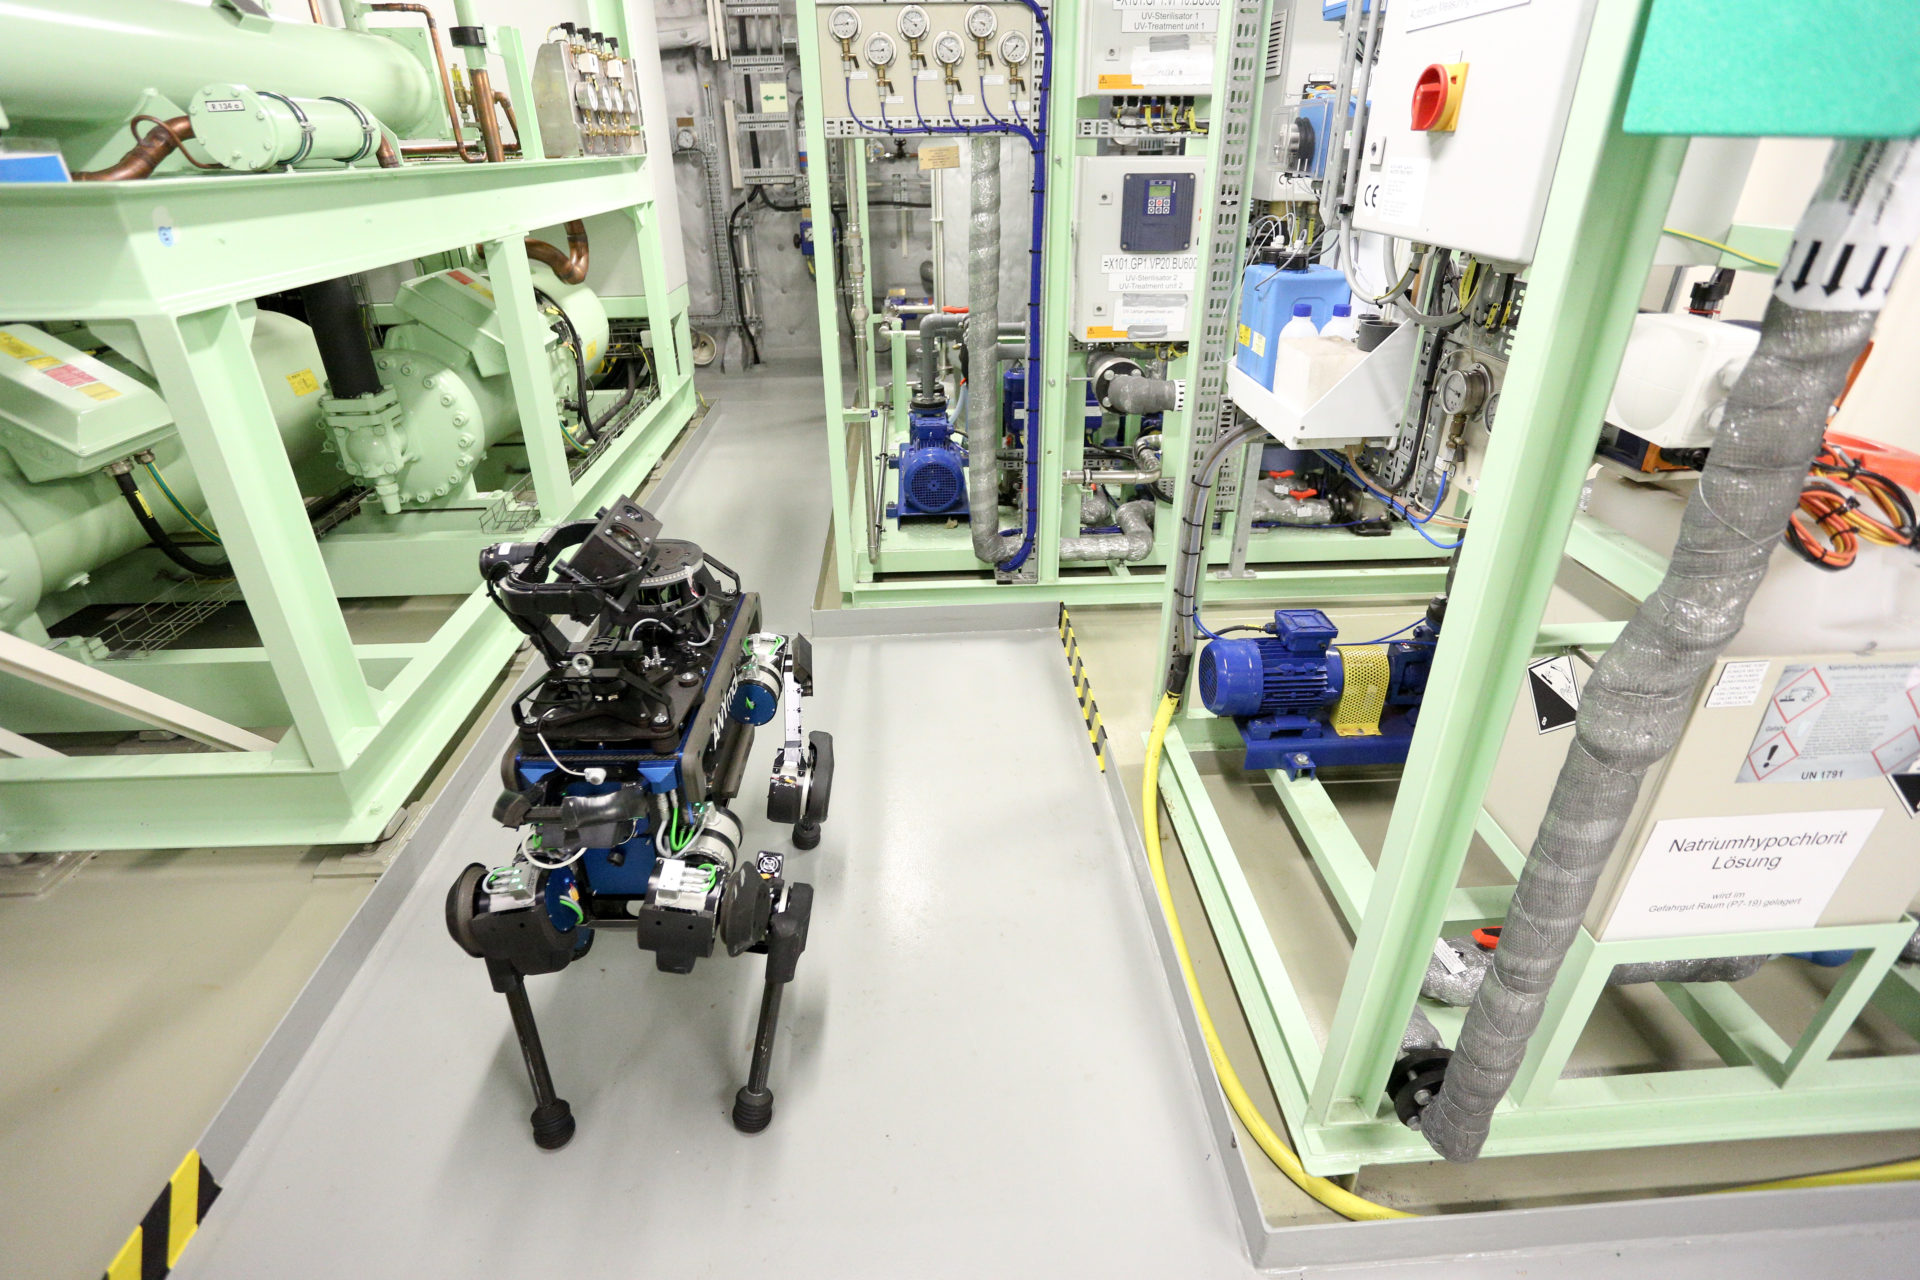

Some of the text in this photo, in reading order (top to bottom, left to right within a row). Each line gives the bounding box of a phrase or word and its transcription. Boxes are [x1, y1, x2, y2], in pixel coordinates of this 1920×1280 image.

[1141, 12, 1192, 20] UV-Sterilisator
[1134, 22, 1184, 30] UV-Treatment
[1185, 22, 1199, 30] unit
[1119, 282, 1164, 290] UV-Treatment
[1541, 716, 1548, 726] 8
[1801, 770, 1843, 780] UN 1791
[1668, 830, 1848, 853] Natriumhypochlorit
[1712, 855, 1782, 871] Lösung
[1712, 891, 1745, 900] wird im
[1648, 896, 1802, 913] Gefahrgut Raum (P7-19) gelagert
